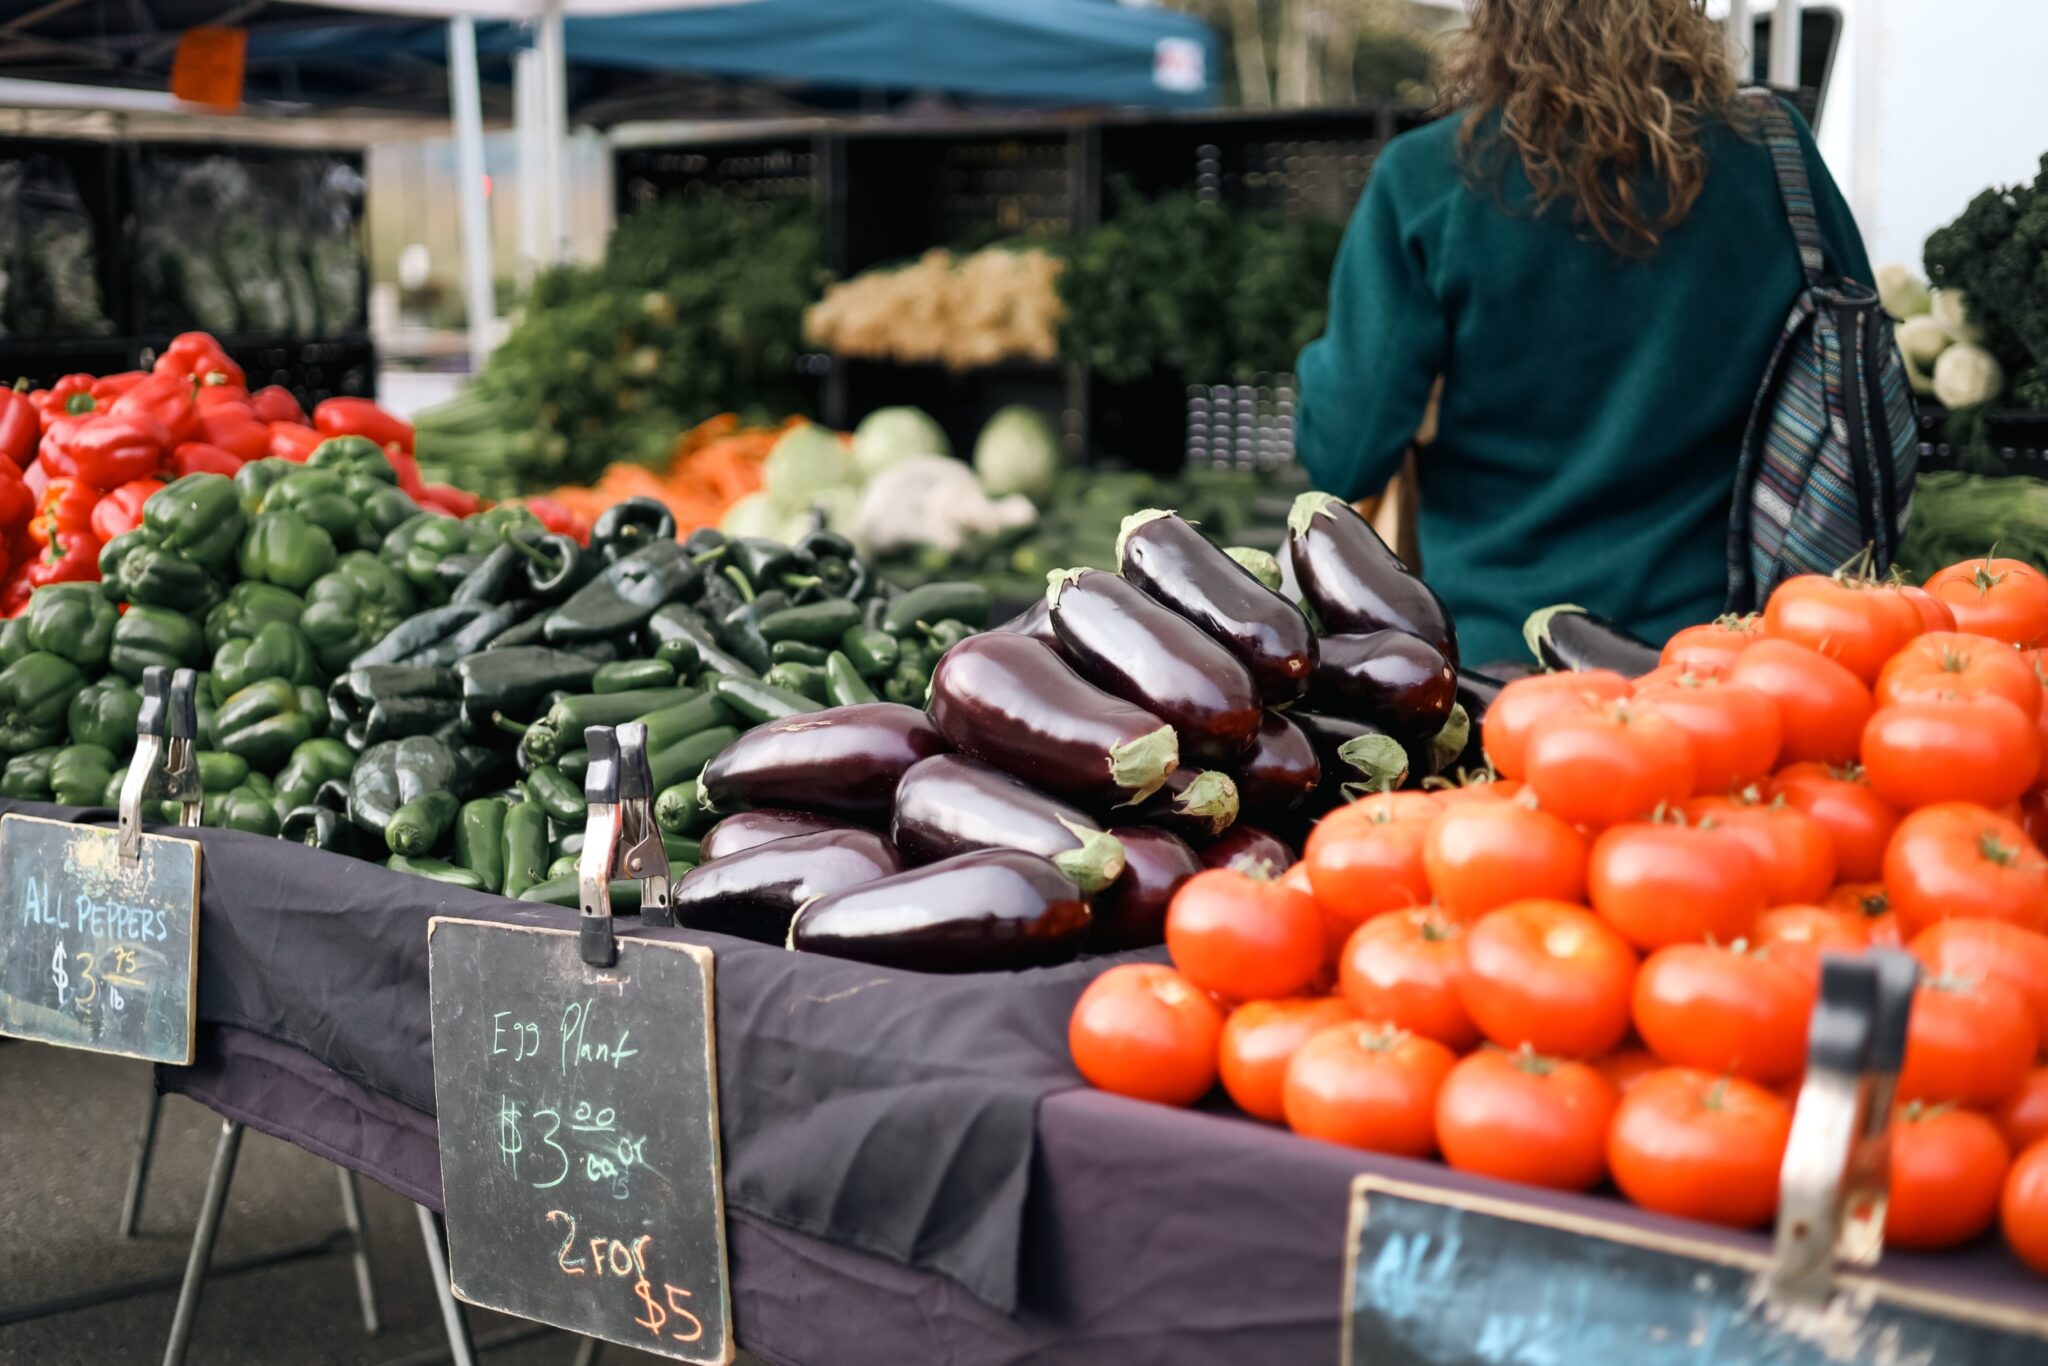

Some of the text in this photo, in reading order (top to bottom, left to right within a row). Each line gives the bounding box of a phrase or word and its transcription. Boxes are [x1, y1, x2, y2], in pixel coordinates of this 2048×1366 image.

[23, 876, 168, 942] ALL PEPPERS
[493, 998, 639, 1076] Egg Plant
[545, 1209, 585, 1274] 2
[634, 1276, 702, 1342] $5
